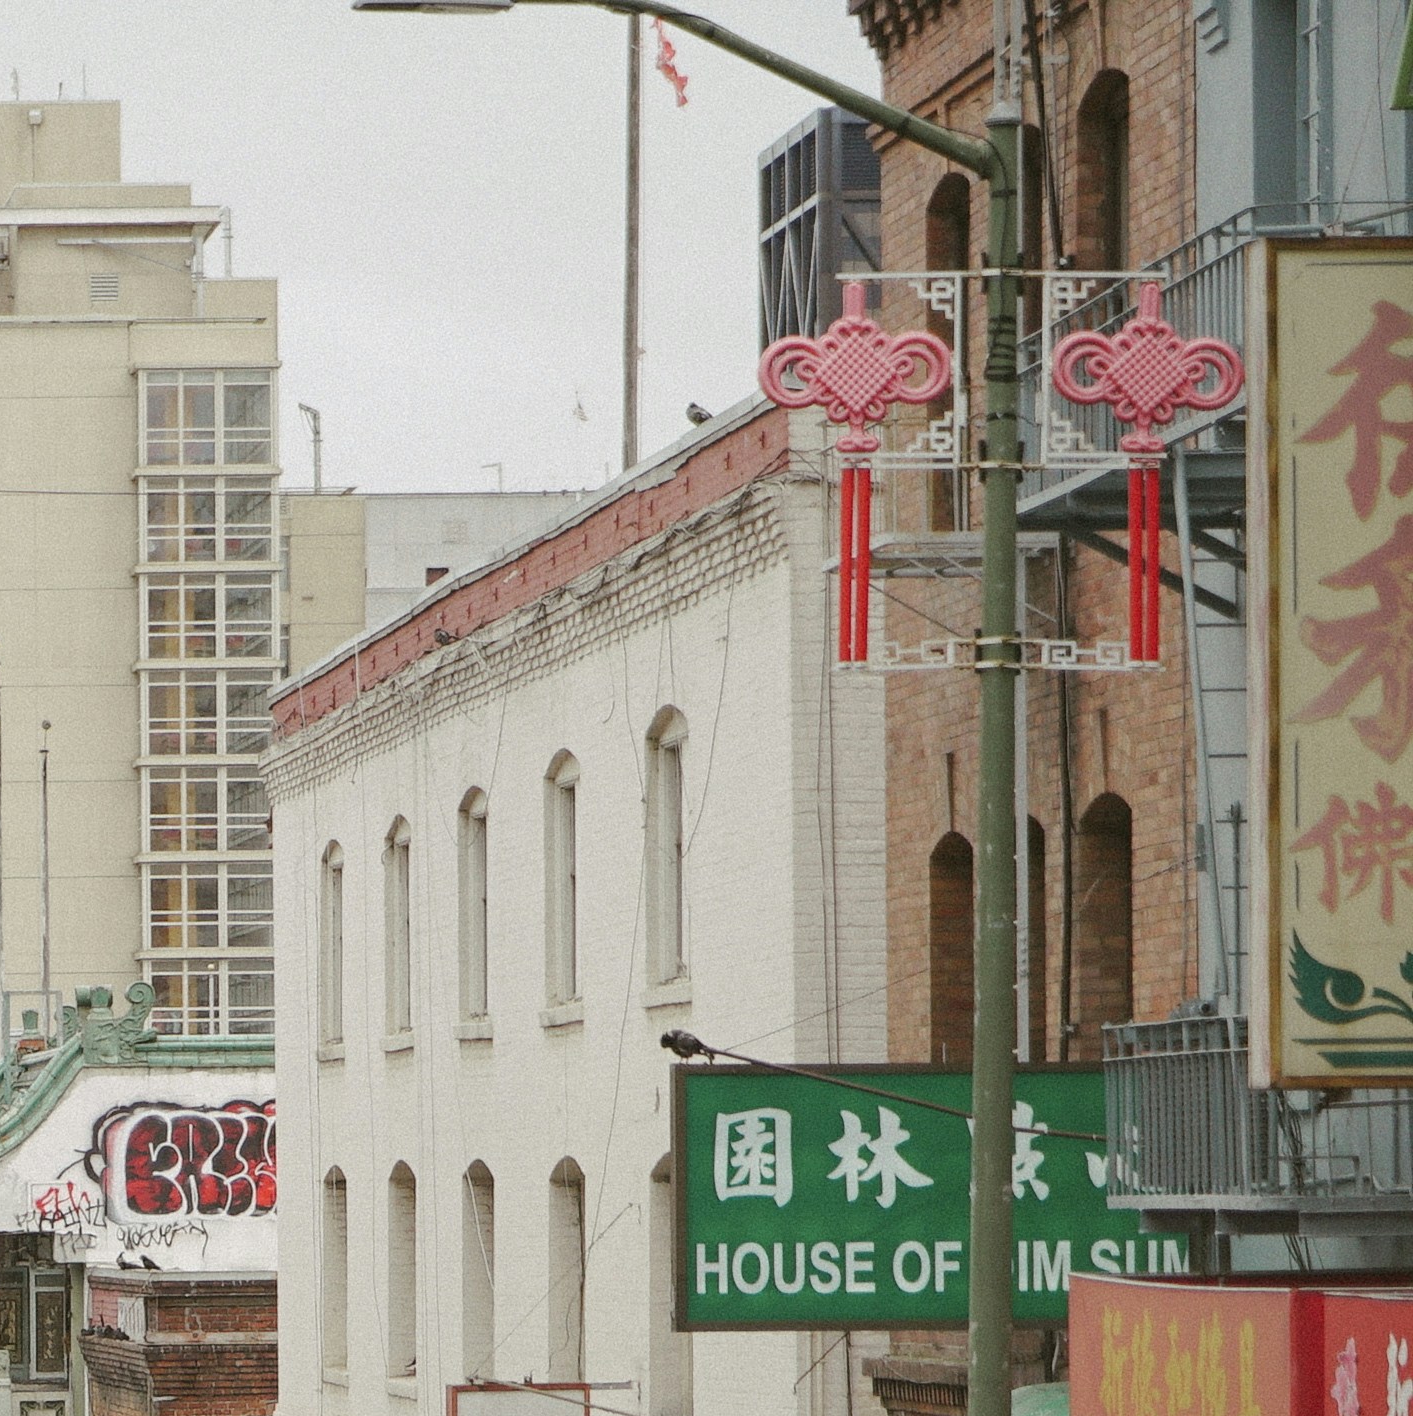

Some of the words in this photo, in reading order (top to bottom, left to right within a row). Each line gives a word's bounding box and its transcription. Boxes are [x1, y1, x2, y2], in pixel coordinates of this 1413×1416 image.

[695, 1242, 875, 1296] HOUSE
[893, 1240, 962, 1294] OF
[1012, 1240, 1070, 1292] IM
